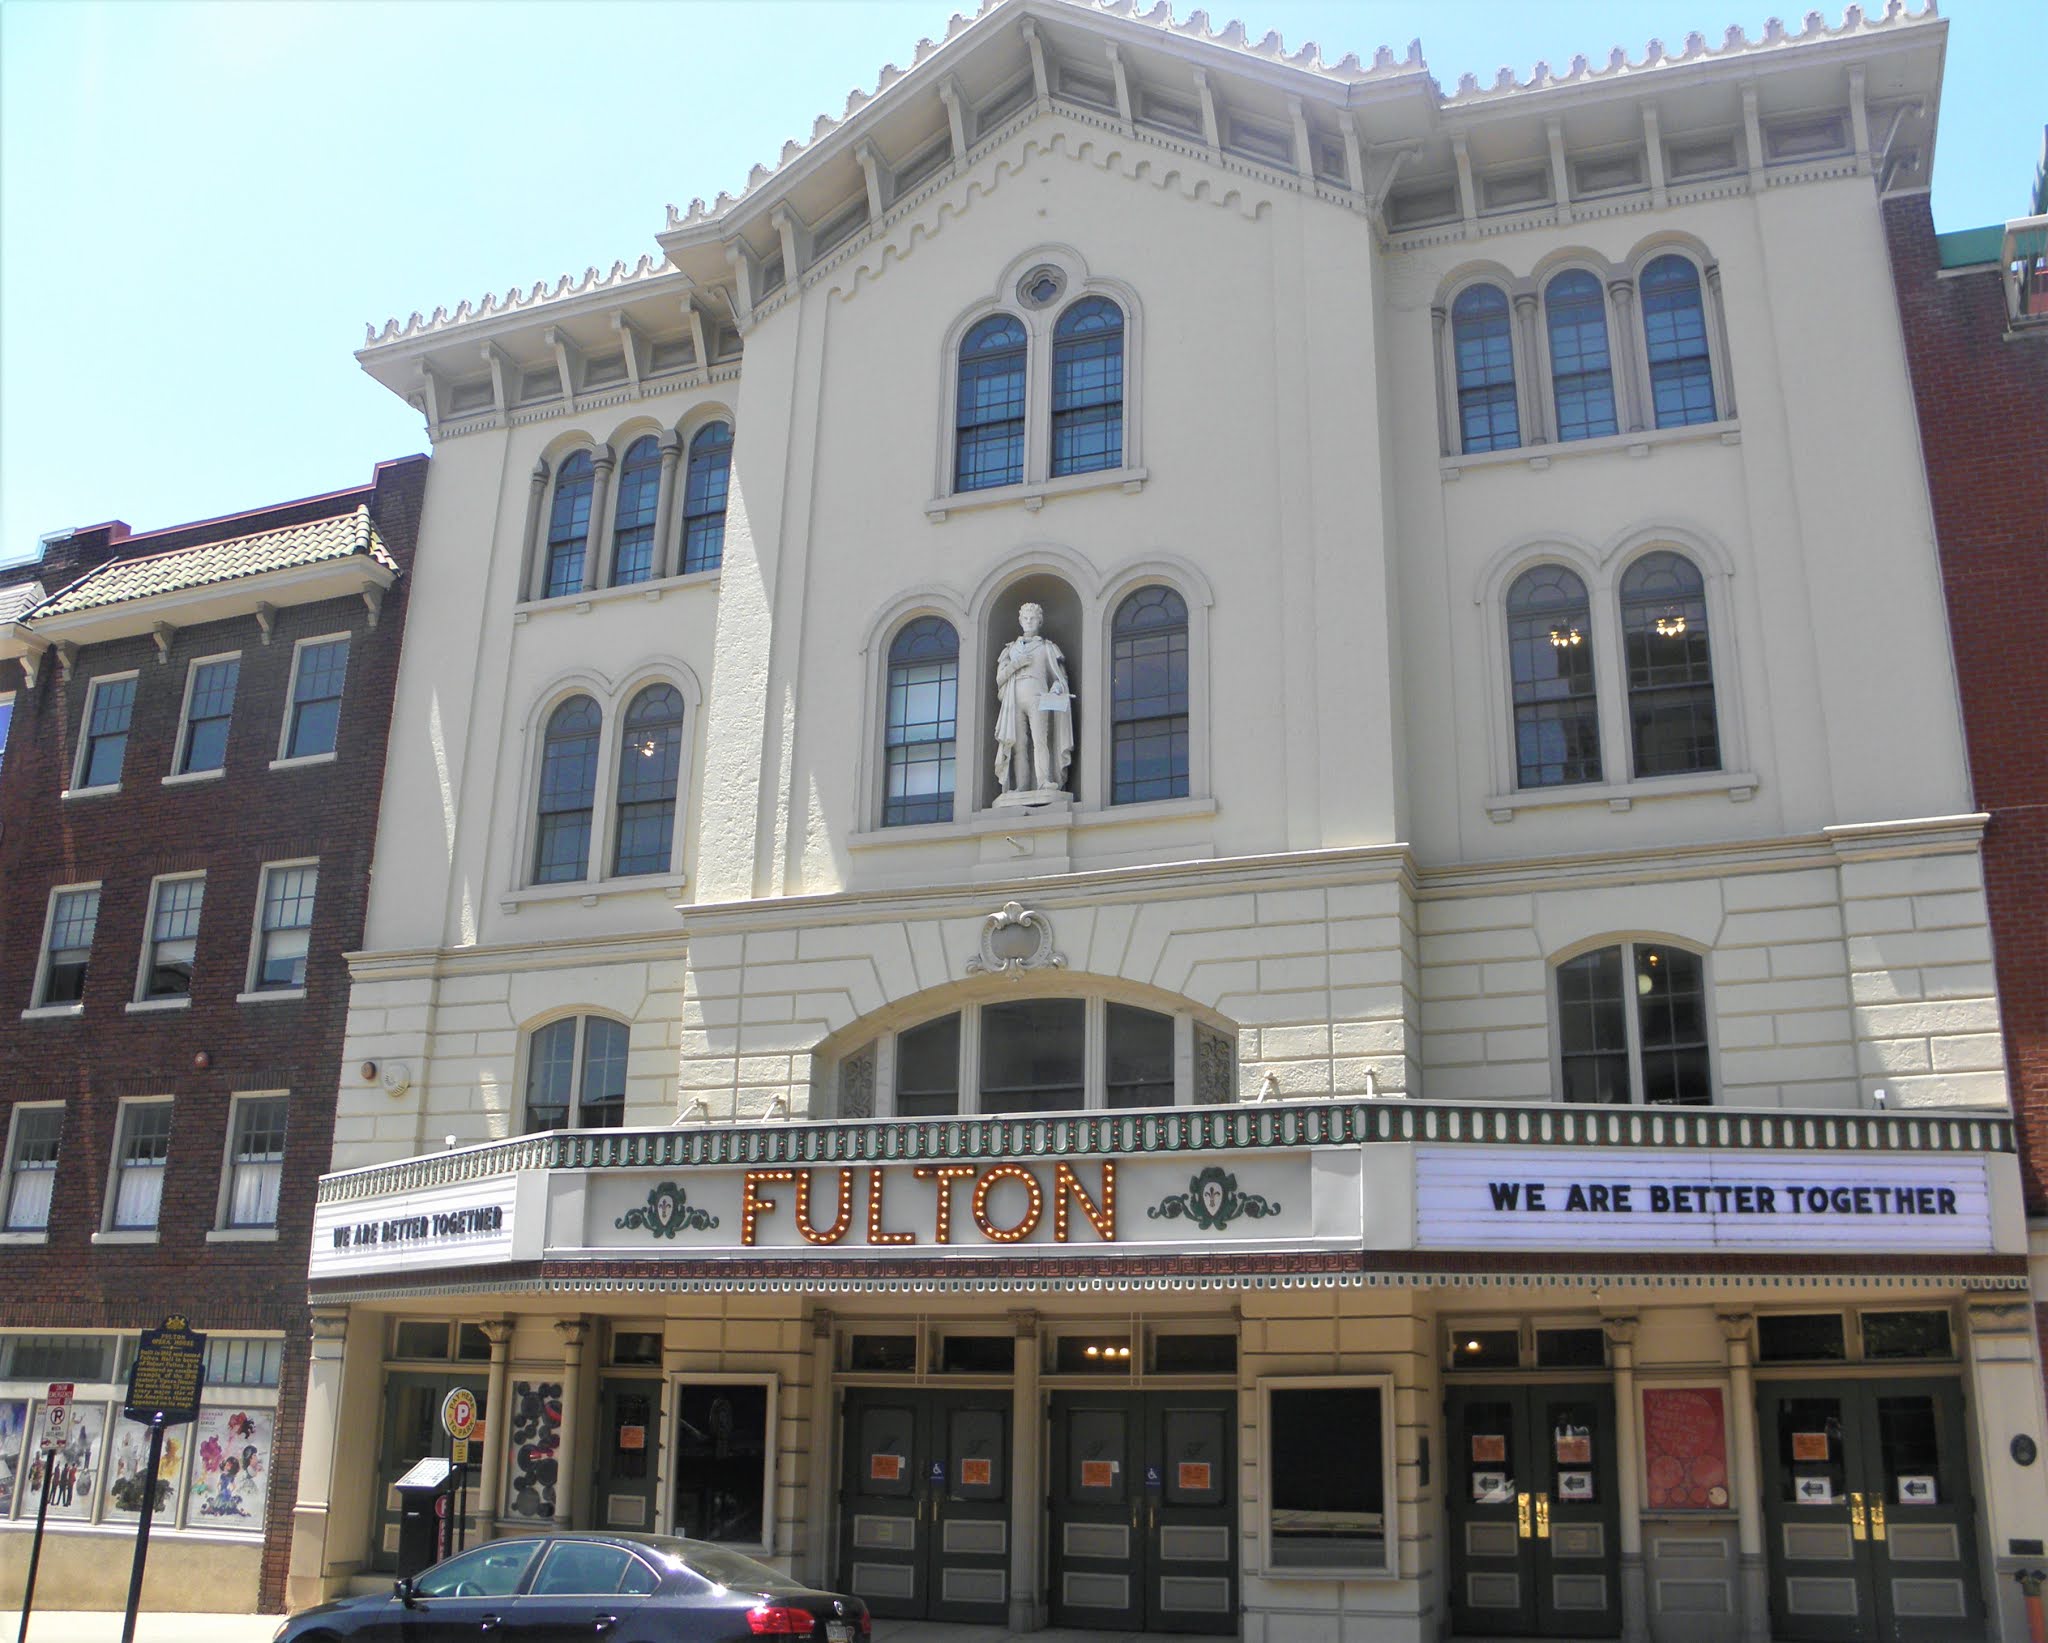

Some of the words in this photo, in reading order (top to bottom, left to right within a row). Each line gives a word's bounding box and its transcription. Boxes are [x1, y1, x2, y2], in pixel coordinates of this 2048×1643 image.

[740, 1160, 1116, 1246] FULTON
[1488, 1183, 1546, 1212] WE
[1564, 1184, 1632, 1213] ARE
[1650, 1185, 1776, 1214] BETTER
[1786, 1186, 1958, 1215] TOGETHER
[333, 1225, 350, 1248] WE
[353, 1222, 378, 1246] ARE
[382, 1215, 429, 1242] BETTER
[432, 1206, 503, 1236] TOGETHER
[450, 1393, 460, 1409] PAY
[462, 1391, 475, 1409] HERE
[449, 1420, 457, 1432] TO
[457, 1404, 469, 1423] P
